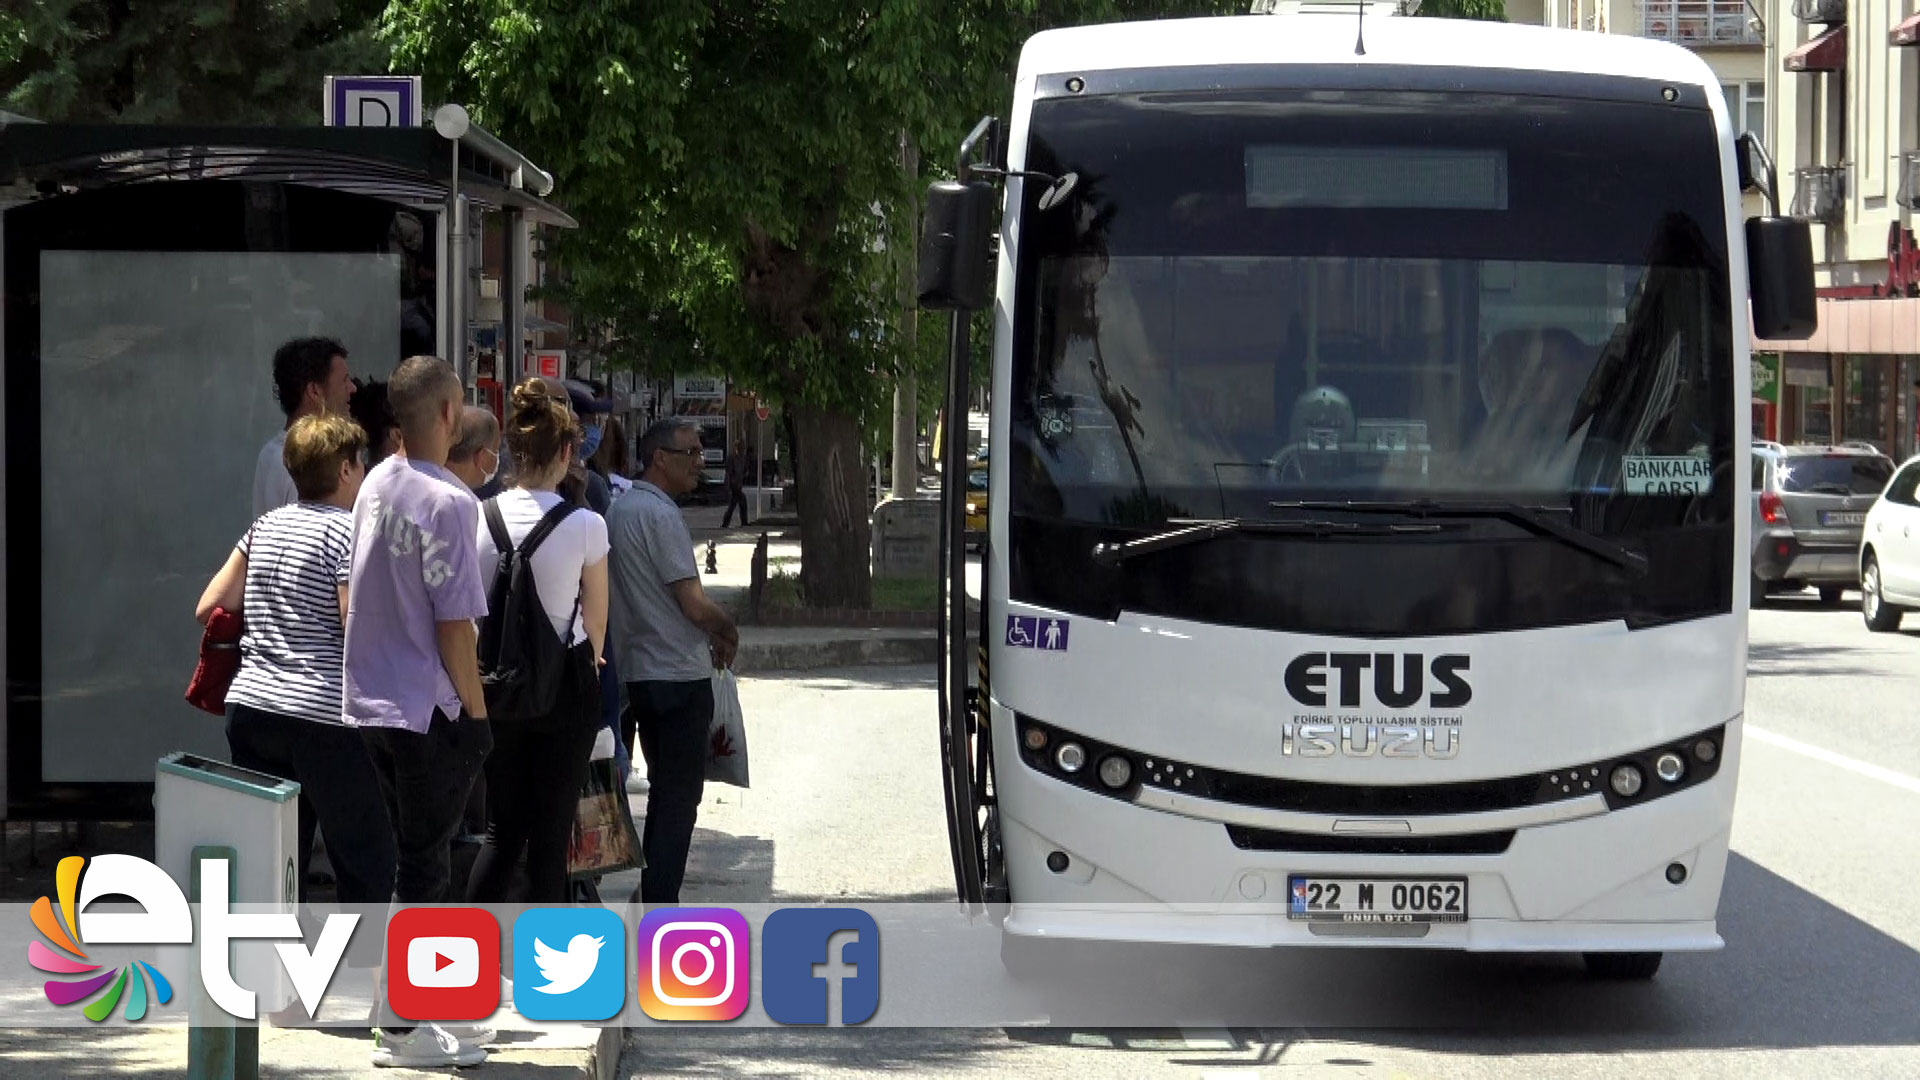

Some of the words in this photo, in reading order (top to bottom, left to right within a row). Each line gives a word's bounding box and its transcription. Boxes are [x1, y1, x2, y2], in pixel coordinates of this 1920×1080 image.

[1284, 652, 1472, 708] ETUS
[1338, 716, 1373, 725] TOPLU
[1282, 723, 1460, 760] ISUZU
[1308, 884, 1341, 910] 22
[1358, 884, 1375, 910] M
[1392, 885, 1460, 912] 0062
